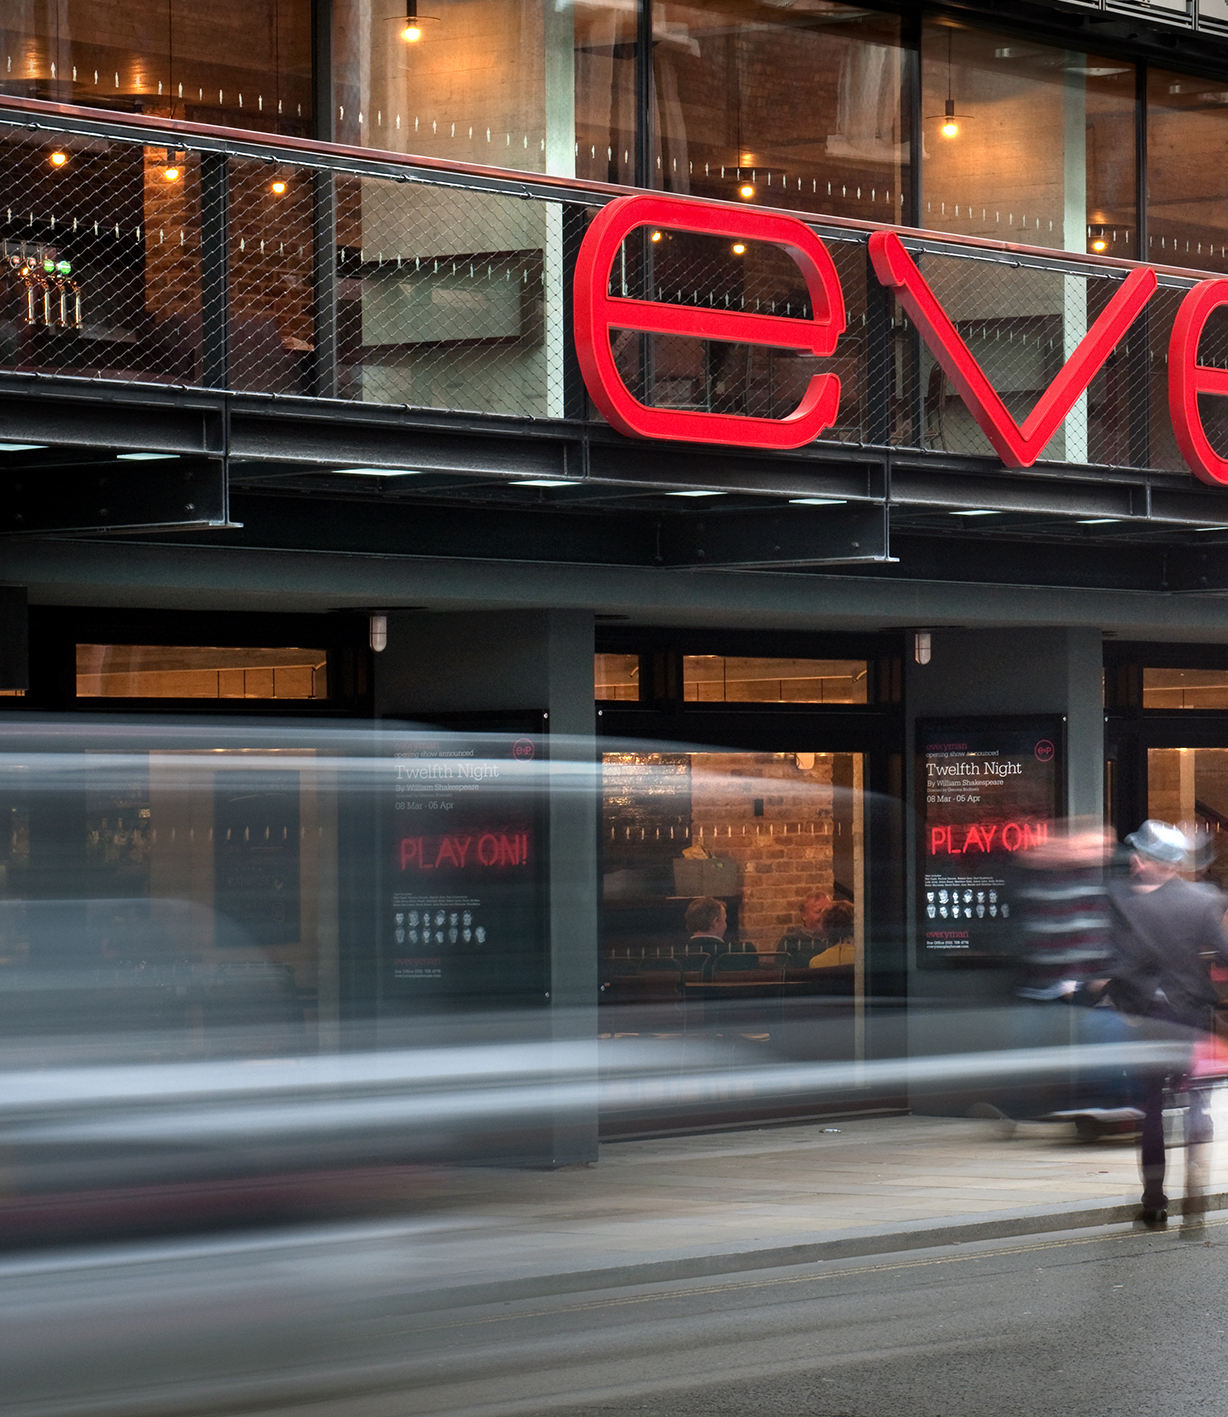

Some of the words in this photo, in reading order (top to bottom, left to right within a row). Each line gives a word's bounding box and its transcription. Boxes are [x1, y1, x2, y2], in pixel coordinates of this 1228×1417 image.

[439, 749, 474, 757] announced
[395, 764, 454, 779] Twelfth
[458, 763, 500, 780] Night
[926, 762, 980, 776] Twelfth
[984, 761, 1022, 777] Night
[396, 784, 405, 792] By
[434, 784, 479, 792] Shakespeare
[927, 780, 935, 788] By
[962, 779, 1004, 787] Shakespeare
[967, 794, 981, 803] Apr
[407, 802, 423, 810] Mar
[440, 801, 454, 810] Apr
[932, 825, 996, 855] PLAY
[401, 836, 472, 870] PLAY
[478, 833, 528, 866] ON!
[926, 931, 969, 940] everyman
